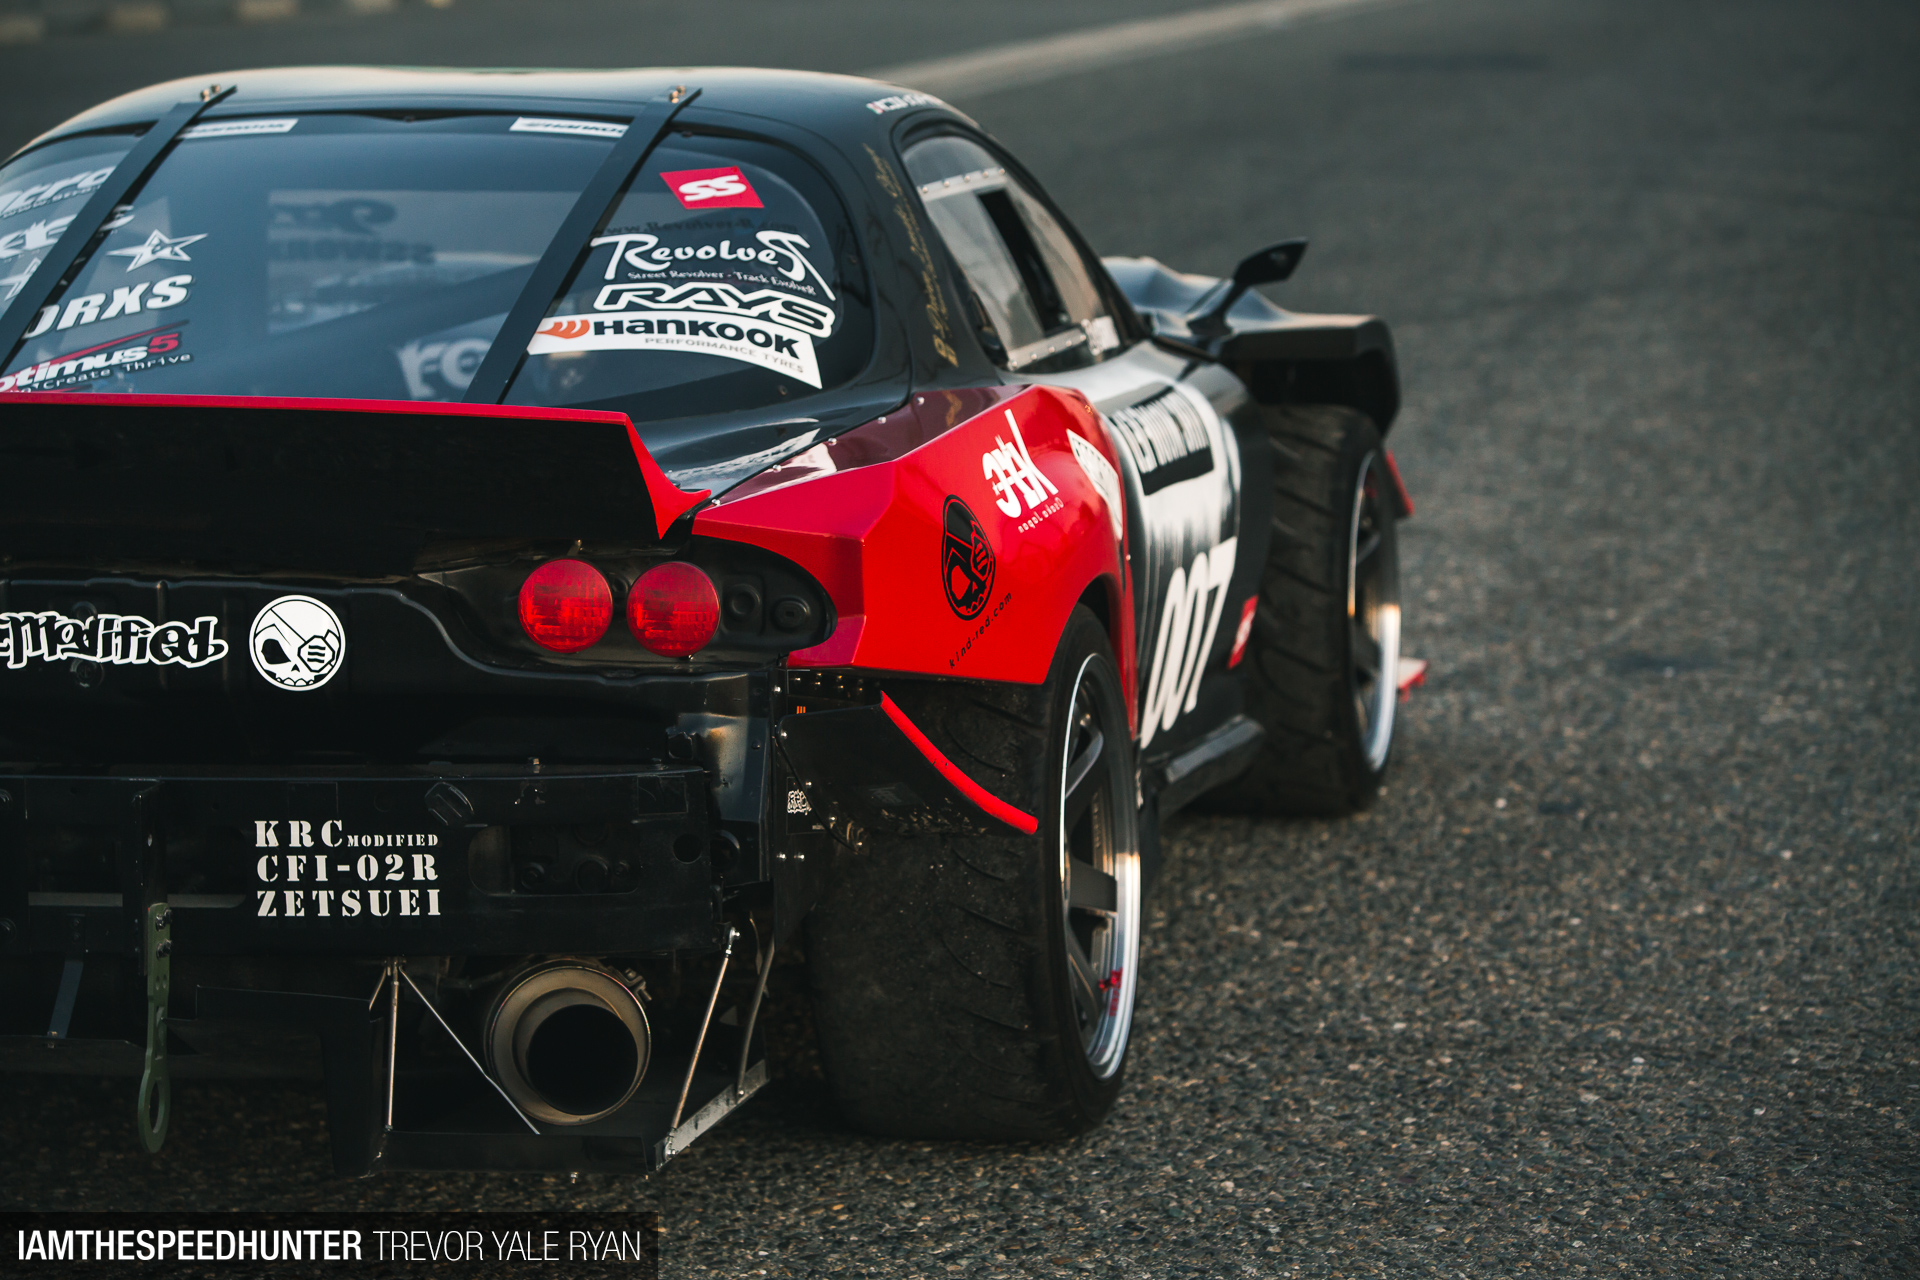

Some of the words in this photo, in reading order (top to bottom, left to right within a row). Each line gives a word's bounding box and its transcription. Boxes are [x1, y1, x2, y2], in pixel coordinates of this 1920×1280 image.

[628, 271, 667, 280] Street
[669, 269, 724, 280] Revolver
[733, 270, 769, 284] Track
[594, 281, 836, 338] RAYS
[43, 368, 112, 390] Create
[121, 352, 192, 373] Thrive
[644, 336, 757, 357] PERFORMANCE
[760, 352, 805, 374] TYRES
[949, 592, 1012, 670] kind-red.com
[1140, 536, 1238, 750] 007
[254, 819, 343, 848] KRC
[346, 833, 439, 847] MODIFIED
[256, 853, 439, 883] CFI-02R
[256, 888, 441, 917] ZETSUEI
